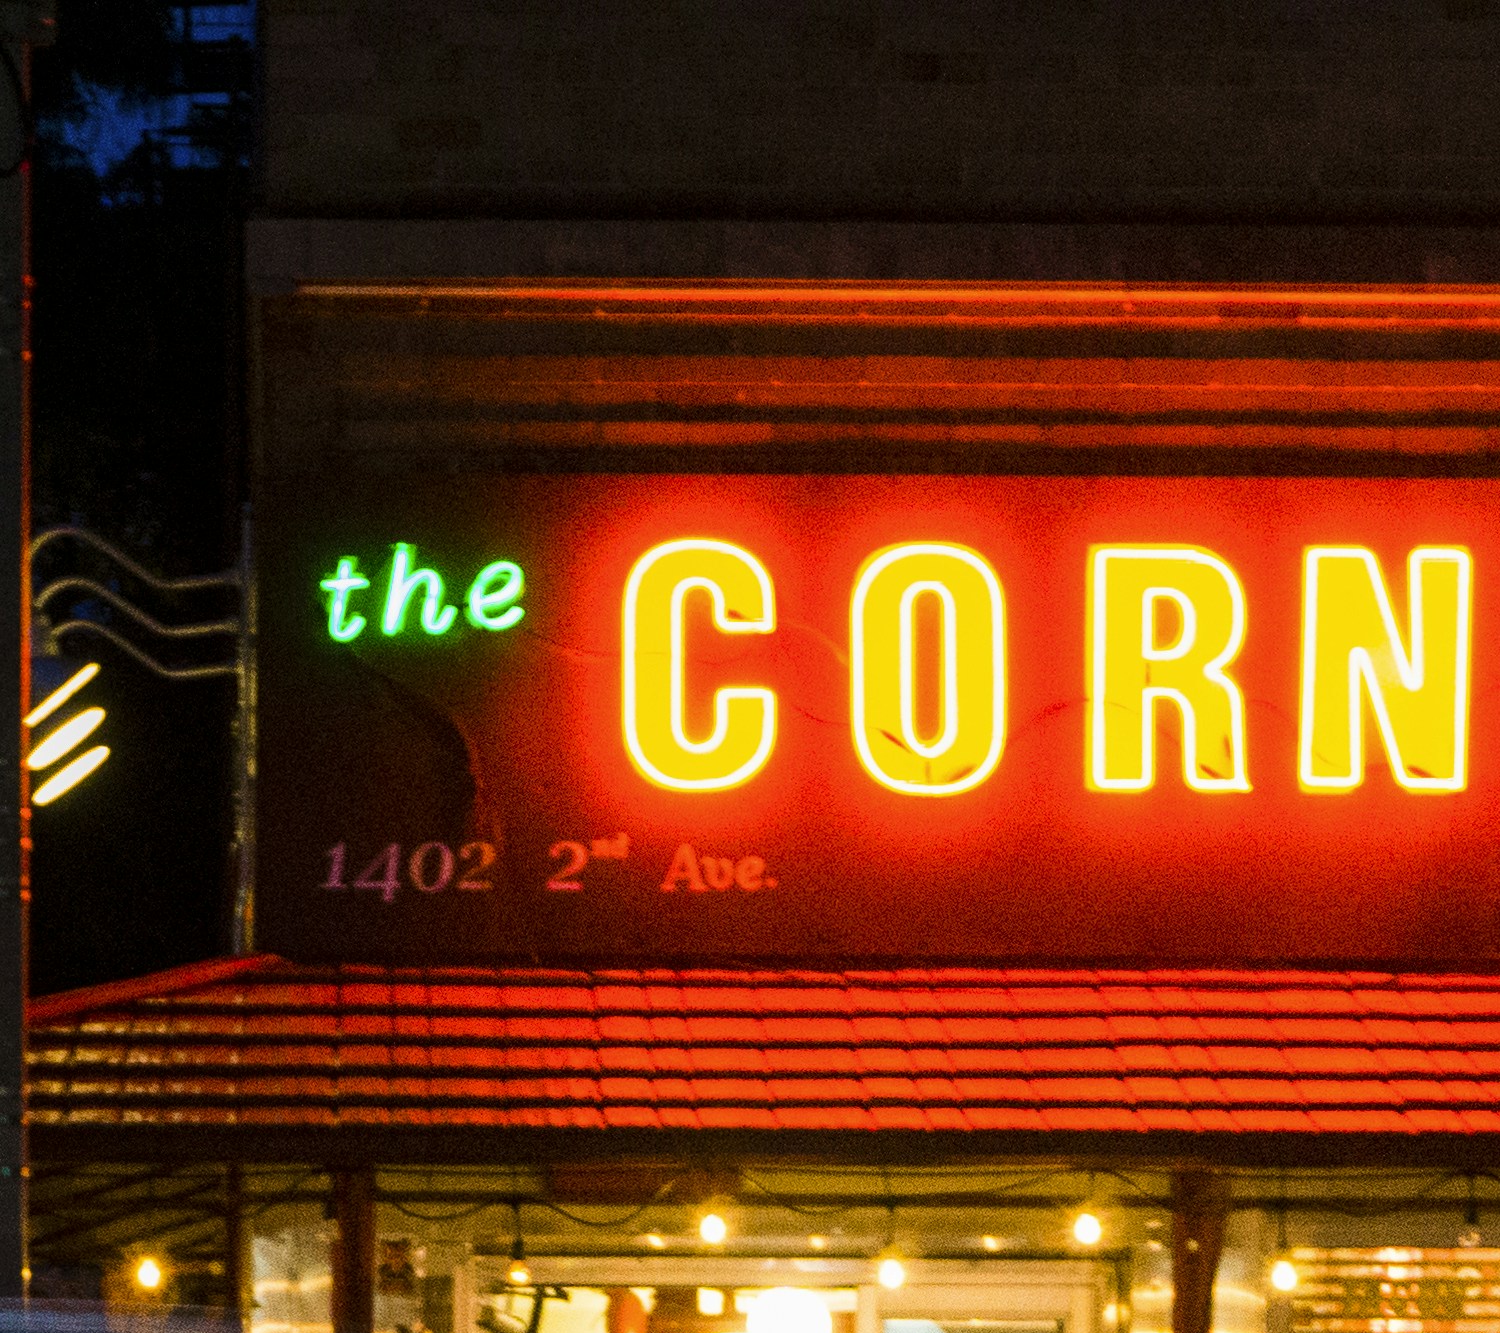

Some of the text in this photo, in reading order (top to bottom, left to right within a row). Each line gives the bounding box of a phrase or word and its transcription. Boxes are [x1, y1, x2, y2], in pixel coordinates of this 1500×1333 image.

[320, 541, 526, 641] the
[322, 841, 497, 902] 1402
[661, 843, 777, 893] Ave.
